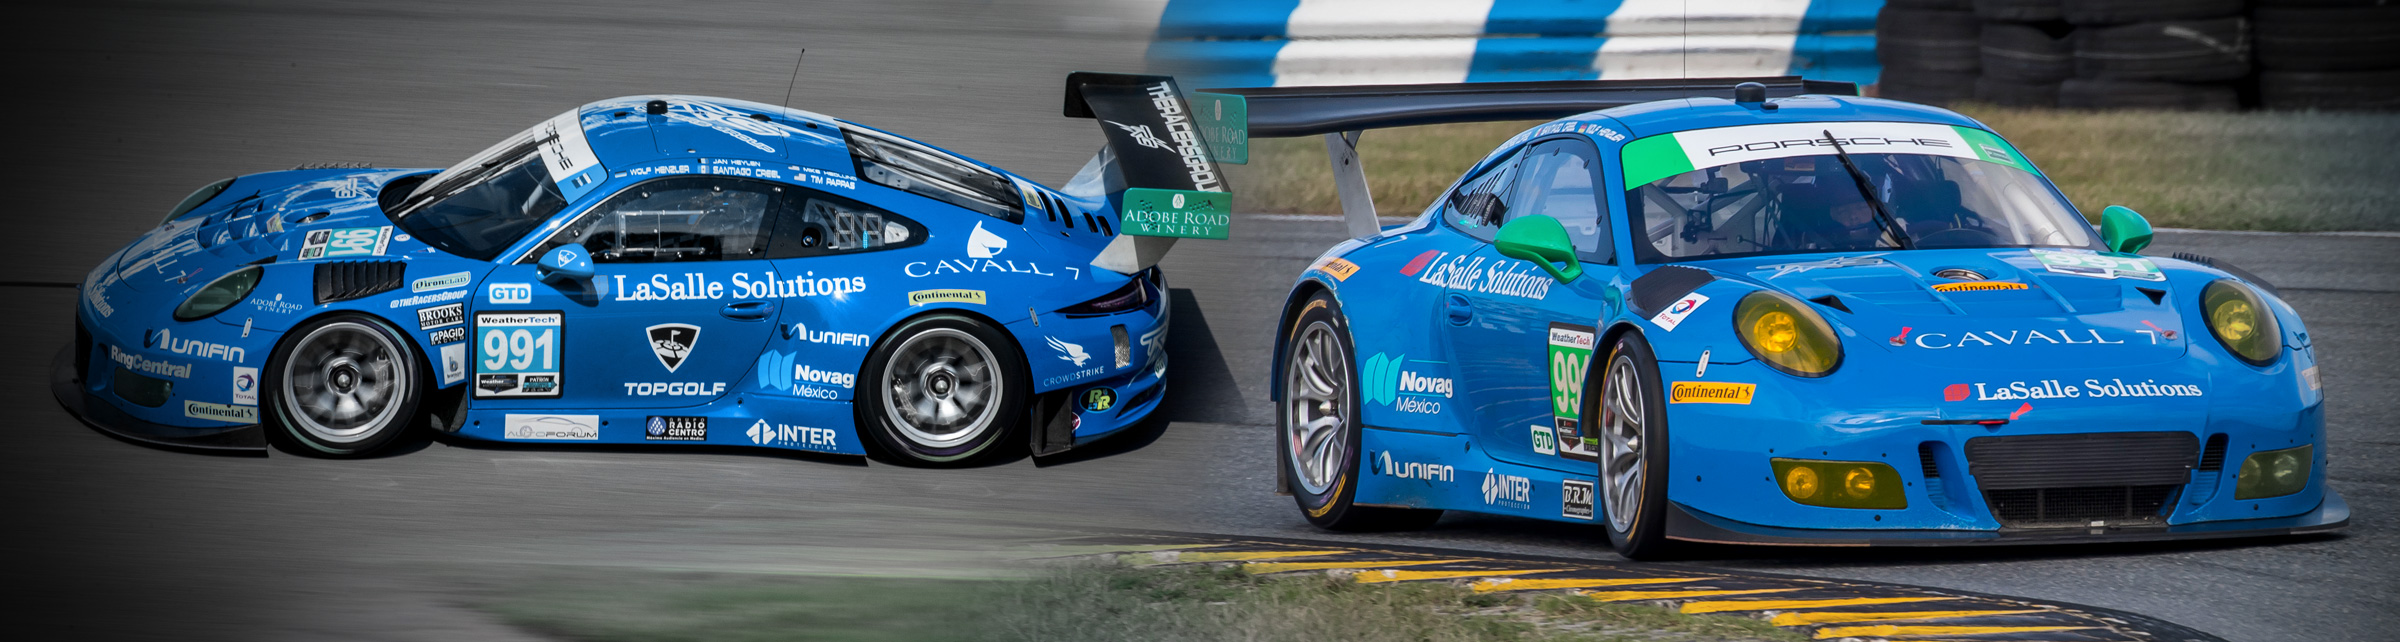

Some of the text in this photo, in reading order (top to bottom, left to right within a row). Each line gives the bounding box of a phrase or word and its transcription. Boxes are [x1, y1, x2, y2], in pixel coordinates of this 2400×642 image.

[1146, 81, 1222, 193] THERACERSGROU
[1708, 136, 1953, 157] PORSCHE
[713, 165, 752, 177] SANTIAGO
[811, 175, 856, 190] TIM PAPPAS
[1124, 209, 1231, 227] ADOBE ROAD
[1140, 223, 1212, 236] WINERY
[327, 228, 378, 257] 991
[904, 258, 1054, 278] CAVALL
[1419, 251, 1554, 301] LaSalle Solutions
[491, 286, 530, 301] GTD
[613, 270, 867, 301] LaSalle Solutions
[250, 298, 303, 312] ADOBE ROAD
[912, 290, 973, 302] Continental
[257, 305, 293, 316] WINERY
[419, 306, 463, 322] BROOKS
[1659, 312, 1677, 326] TOTAL
[481, 315, 556, 325] WeatherTech
[438, 327, 465, 340] PAGID
[809, 330, 870, 347] UNIFIN
[1552, 331, 1591, 346] WeatherTech
[1915, 328, 2158, 350] CAVALL 7
[171, 337, 246, 364] UNIFIN
[483, 328, 554, 371] 991
[110, 344, 193, 379] RingCentral
[794, 363, 856, 390] Novag
[1043, 365, 1105, 388] CROWDSTRIKE
[1399, 370, 1454, 399] Novag
[235, 393, 257, 401] TOTAL
[624, 382, 727, 396] TOPGOLF
[792, 383, 838, 400] México
[1672, 384, 1742, 402] Continental
[1977, 376, 2204, 401] LaSalle Solutions
[187, 402, 245, 420] Continental
[1396, 396, 1441, 415] México
[507, 429, 598, 439] AUTOFORUM
[668, 428, 705, 437] CENTRO
[669, 421, 705, 430] RADIO
[778, 423, 836, 446] INTER
[1533, 429, 1554, 451] GTD
[1394, 461, 1455, 483] UNIFIN
[1499, 473, 1531, 503] INTER
